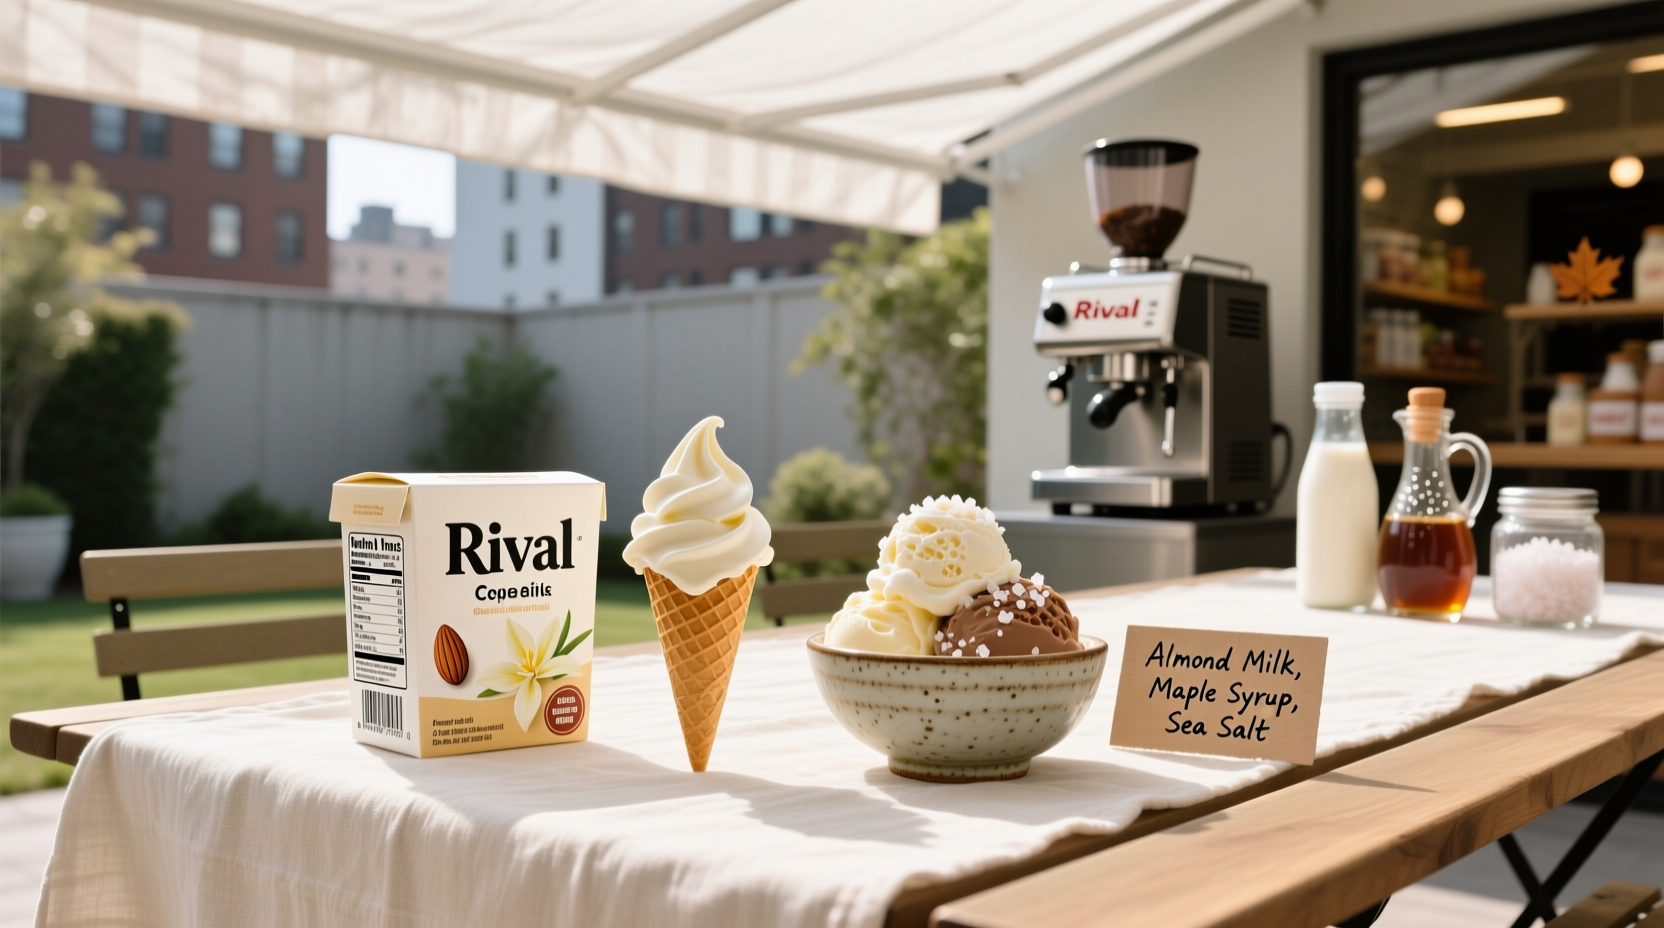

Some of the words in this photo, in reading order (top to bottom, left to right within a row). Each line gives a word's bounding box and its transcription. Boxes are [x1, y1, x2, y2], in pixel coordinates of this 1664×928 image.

[1074, 298, 1140, 320] Rival
[444, 517, 575, 575] Rival
[1144, 641, 1234, 672] Almond
[1242, 648, 1301, 681] Milk,
[1148, 676, 1217, 711] Maple
[1226, 681, 1299, 718] Syrup,
[1164, 710, 1208, 737] Sea
[1216, 714, 1271, 742] Salt
